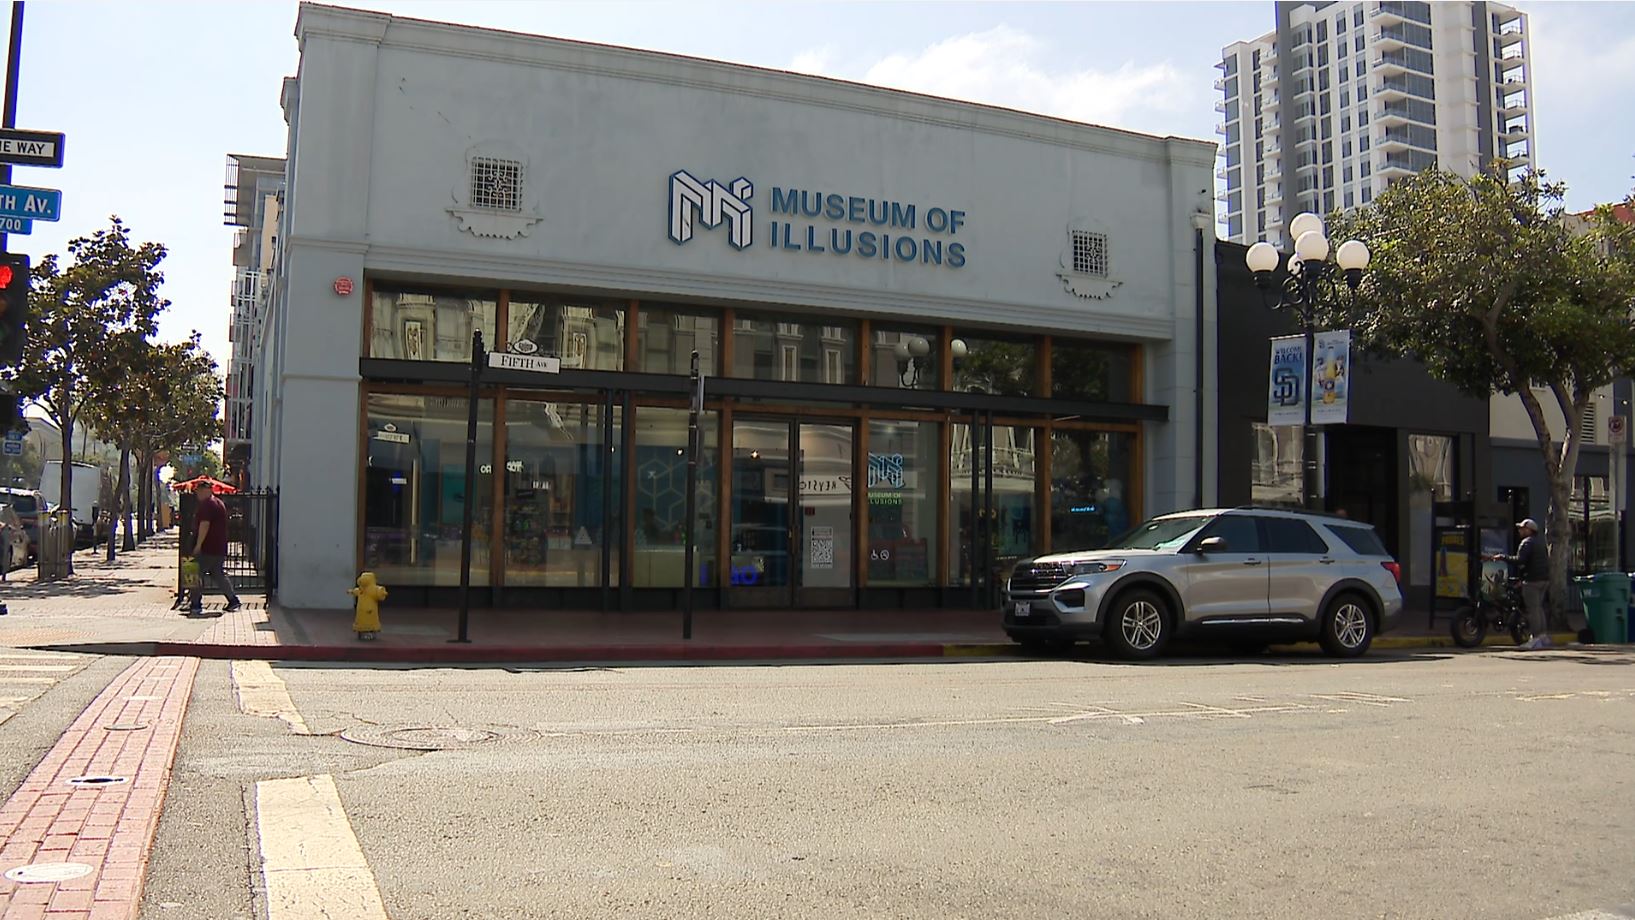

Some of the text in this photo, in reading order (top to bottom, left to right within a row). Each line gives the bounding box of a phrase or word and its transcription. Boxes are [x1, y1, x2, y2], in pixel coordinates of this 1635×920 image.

[0, 141, 45, 154] E WAY
[770, 187, 966, 234] MUSEUM OF
[770, 221, 967, 268] ILLUSIONS
[501, 355, 534, 368] FIFTH
[1274, 352, 1302, 365] BACK!
